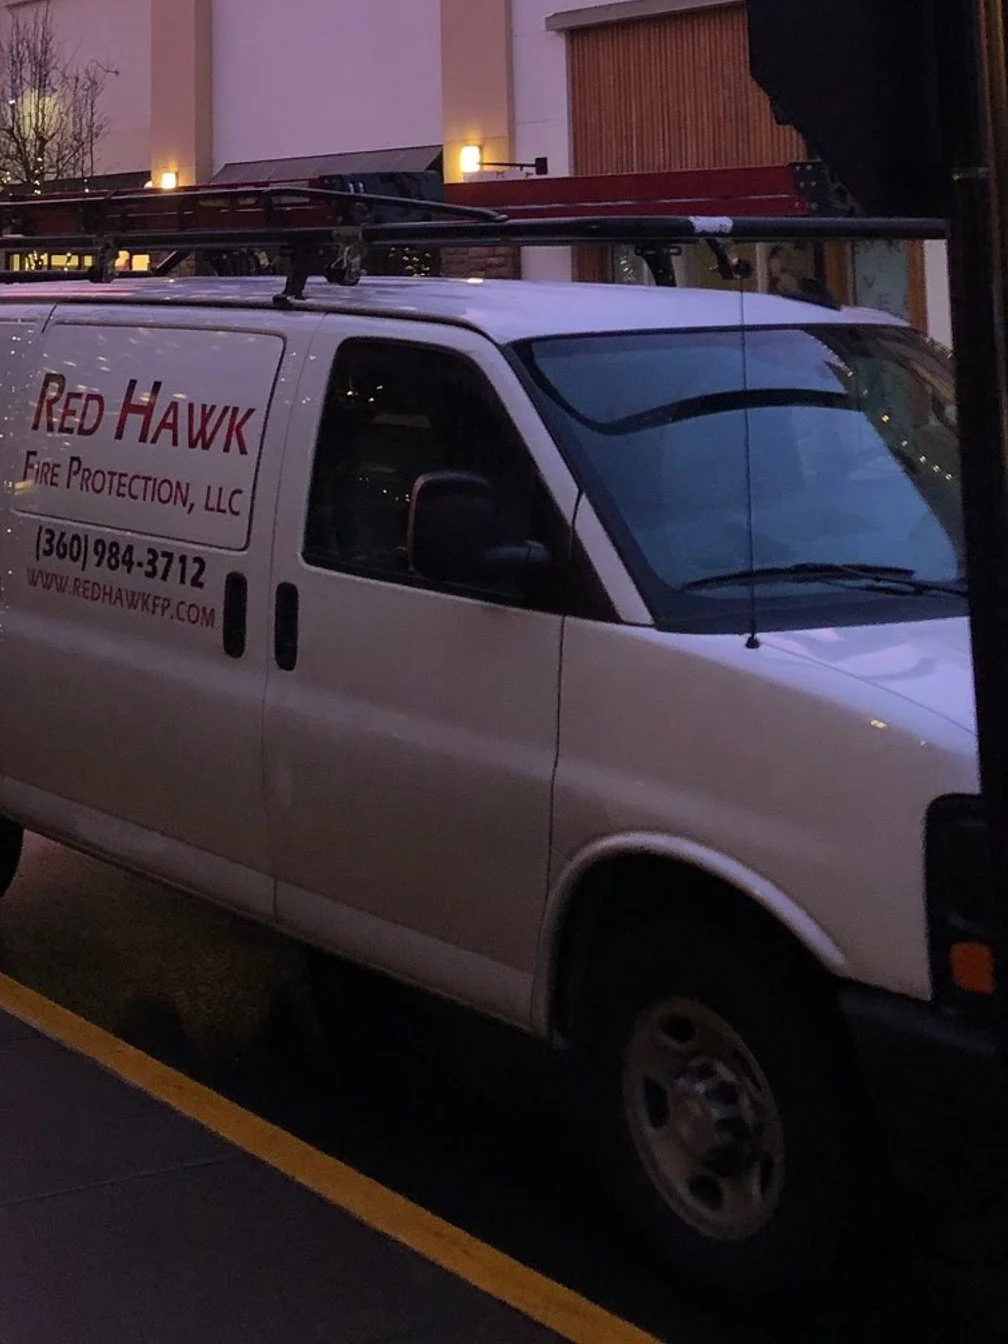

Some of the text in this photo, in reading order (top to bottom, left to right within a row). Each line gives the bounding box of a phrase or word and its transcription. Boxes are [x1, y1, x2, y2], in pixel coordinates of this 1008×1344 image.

[204, 484, 245, 517] LLC
[35, 524, 208, 591] (360) 984-3712
[26, 567, 217, 630] WWW.REDHAWKFP.COM
